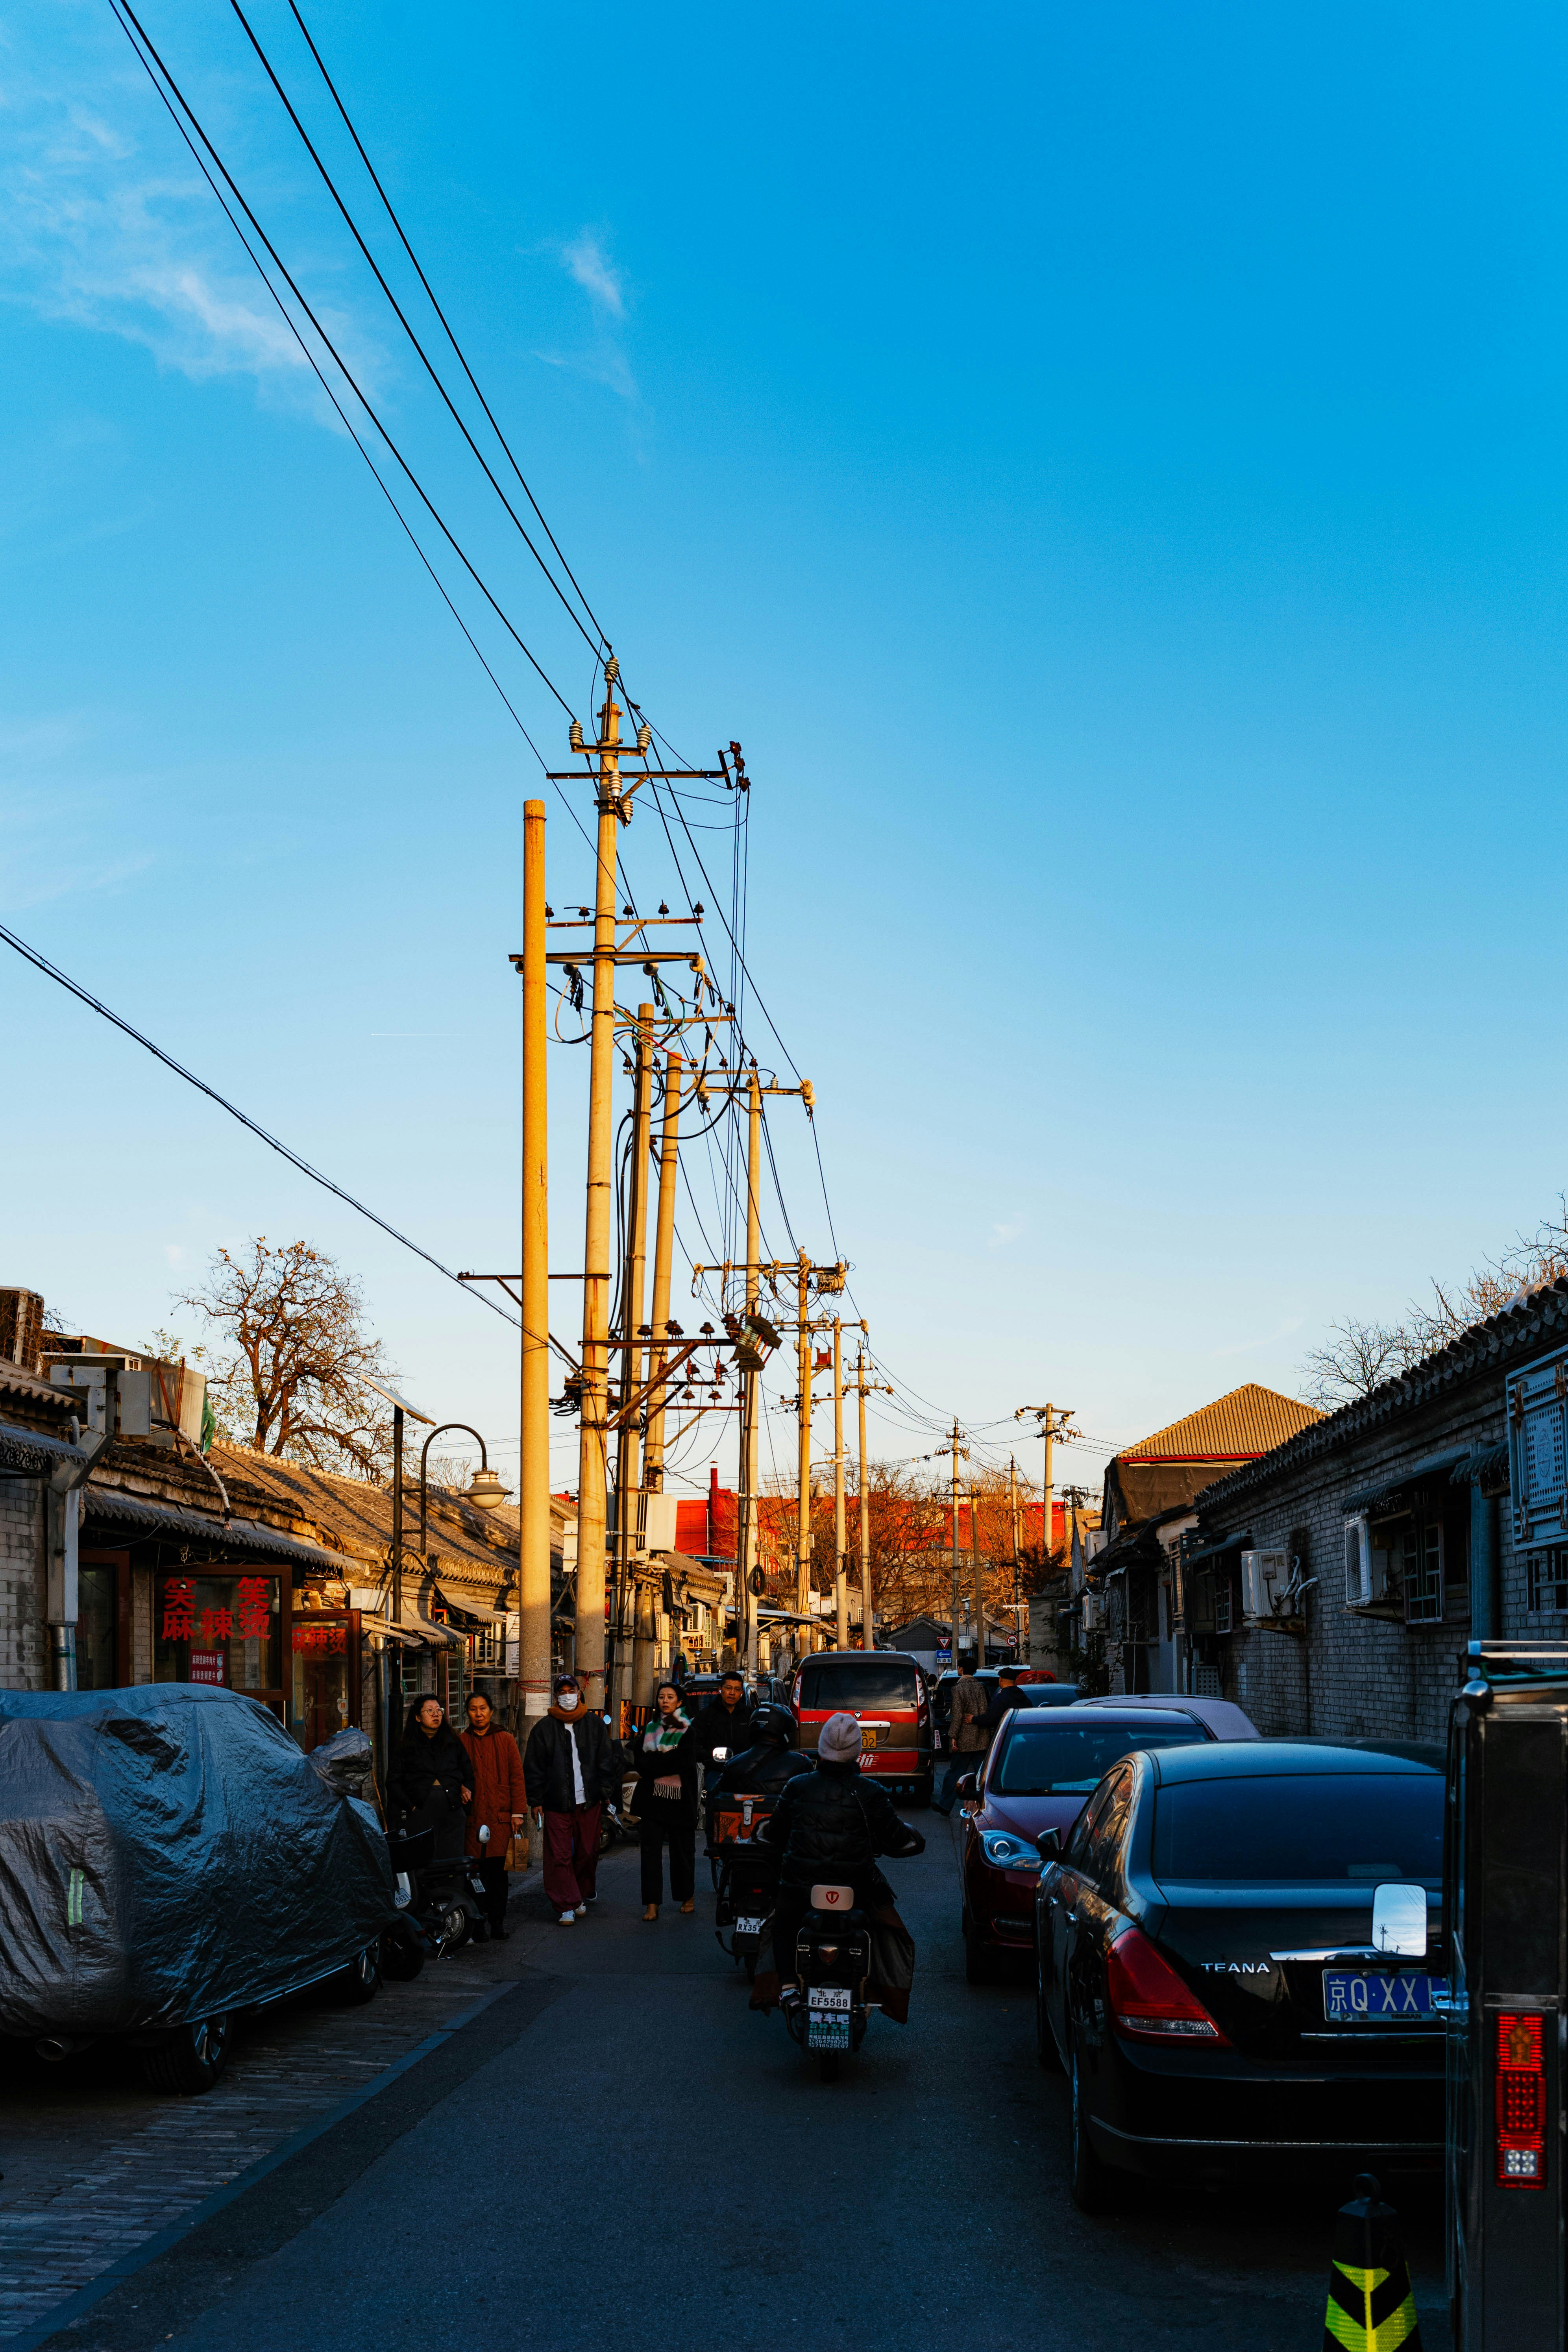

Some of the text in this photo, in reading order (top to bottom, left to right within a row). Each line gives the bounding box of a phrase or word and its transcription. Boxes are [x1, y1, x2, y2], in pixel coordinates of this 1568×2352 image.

[164, 1577, 270, 1609] 笑 笑
[162, 1608, 271, 1640] 麻辣烫
[292, 1627, 348, 1655] 麻辣烫
[856, 1754, 875, 1768] 拉
[738, 1924, 761, 1932] RX357
[1200, 1963, 1270, 1973] TEANA
[812, 1997, 848, 2007] EF5588
